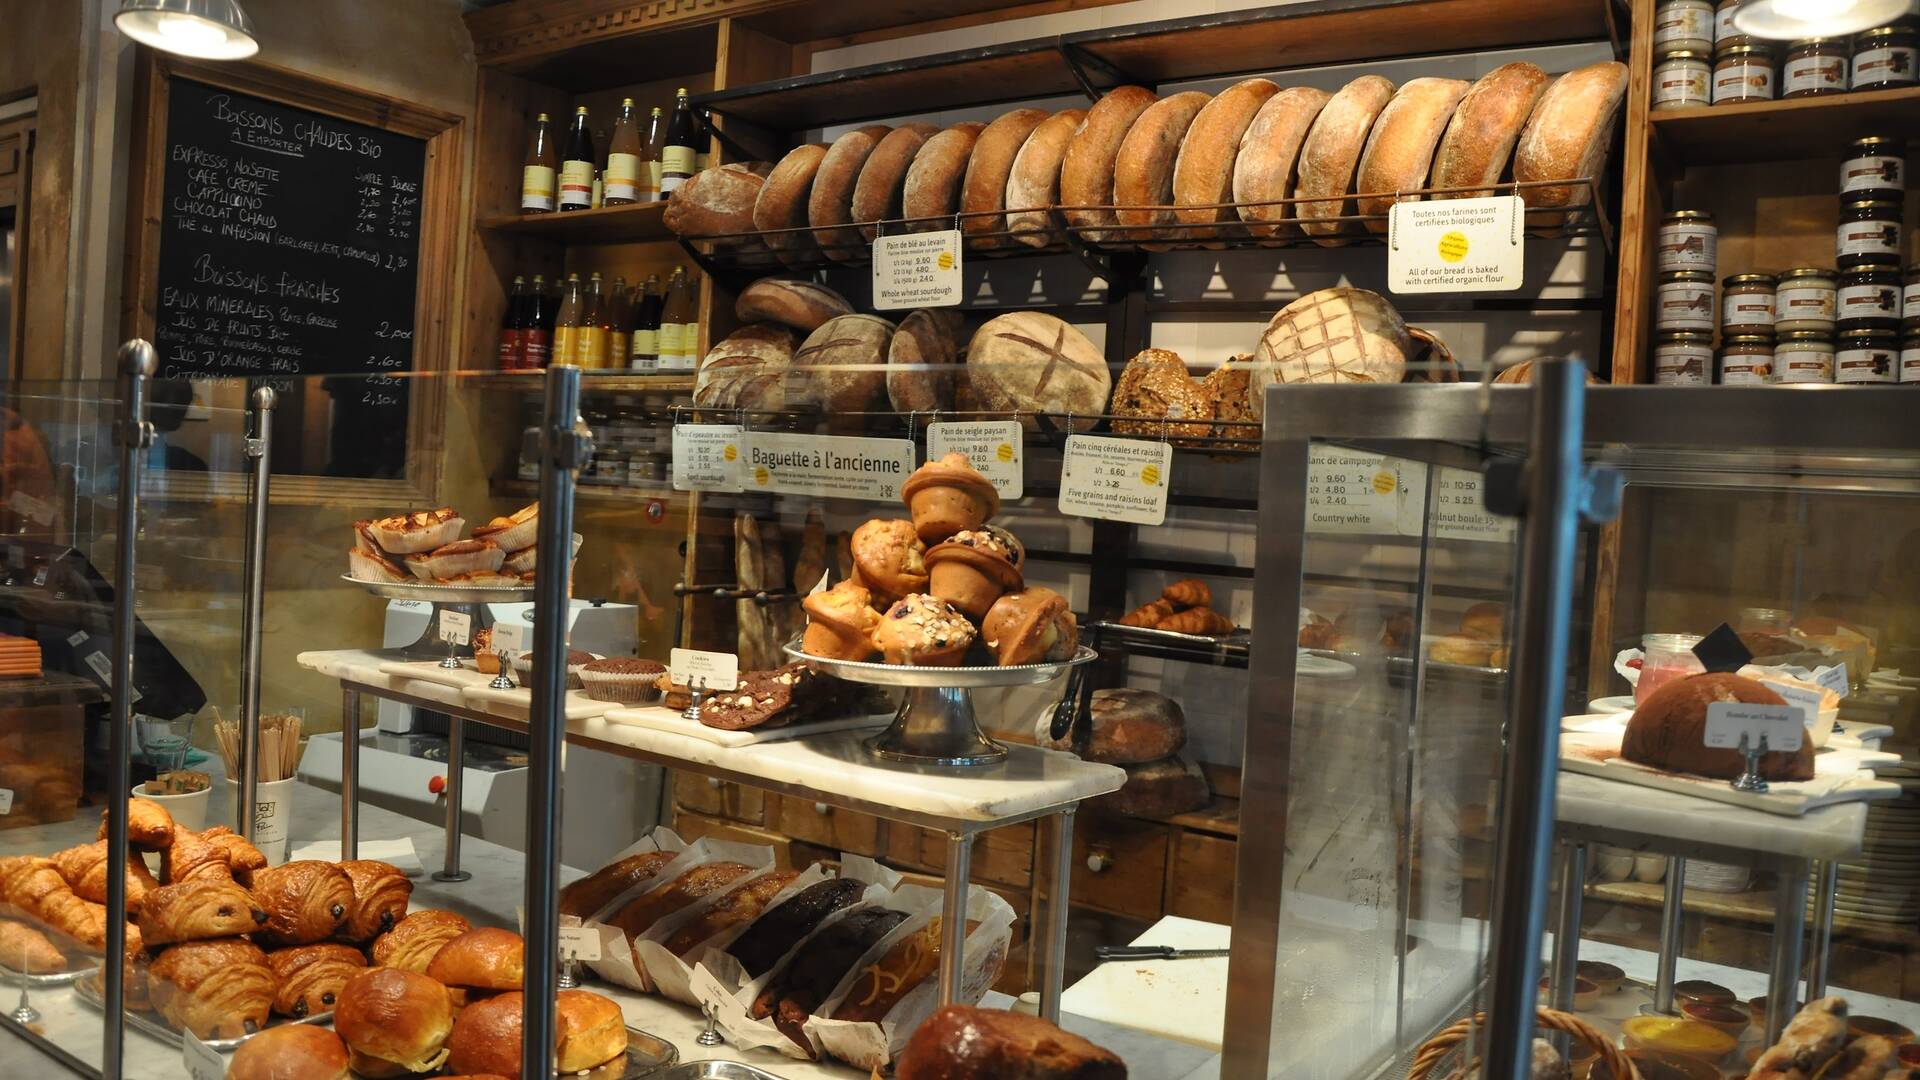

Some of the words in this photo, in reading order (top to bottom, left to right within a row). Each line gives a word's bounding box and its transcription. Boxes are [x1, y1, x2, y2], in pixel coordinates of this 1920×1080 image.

[232, 127, 241, 141] A
[240, 208, 278, 229] CHAUD
[1412, 210, 1435, 219] Toutes
[1437, 209, 1451, 217] nos
[1452, 207, 1479, 216] farines
[1480, 206, 1497, 215] sont
[1451, 215, 1496, 227] biologiques
[886, 242, 899, 251] Pain
[900, 241, 907, 249] de
[928, 237, 946, 246] levain
[1409, 268, 1420, 276] All
[1420, 267, 1429, 276] of
[1444, 266, 1466, 275] bread
[1467, 265, 1474, 274] is
[1476, 265, 1499, 274] baked
[1405, 276, 1422, 285] with
[1423, 274, 1454, 284] certified
[1455, 274, 1484, 286] organic
[1485, 273, 1505, 283] flour
[881, 289, 899, 299] Whole
[901, 288, 919, 297] wheat
[920, 285, 953, 296] sourdough
[941, 427, 954, 435] Pain
[955, 426, 963, 434] de
[964, 426, 983, 437] seigle
[984, 428, 1007, 437] paysan
[1072, 441, 1087, 450] Pain
[1088, 443, 1102, 452] cinq
[1132, 448, 1140, 456] et
[1141, 448, 1164, 458] raisins
[752, 446, 810, 470] Baguette
[812, 449, 822, 468] à
[825, 450, 901, 473] l'ancienne
[1308, 455, 1325, 465] lanc
[1327, 456, 1338, 464] de
[1339, 457, 1382, 467] campagne
[1000, 478, 1010, 487] rye
[1326, 474, 1347, 483] 9.60
[1325, 485, 1346, 494] 4.80
[1069, 488, 1082, 497] Five
[1083, 490, 1104, 500] grains
[1105, 493, 1118, 501] and
[1119, 494, 1142, 505] raisins
[1143, 496, 1159, 506] loaf
[1326, 495, 1347, 504] 2.40
[1312, 512, 1344, 524] Country
[1346, 513, 1371, 523] white
